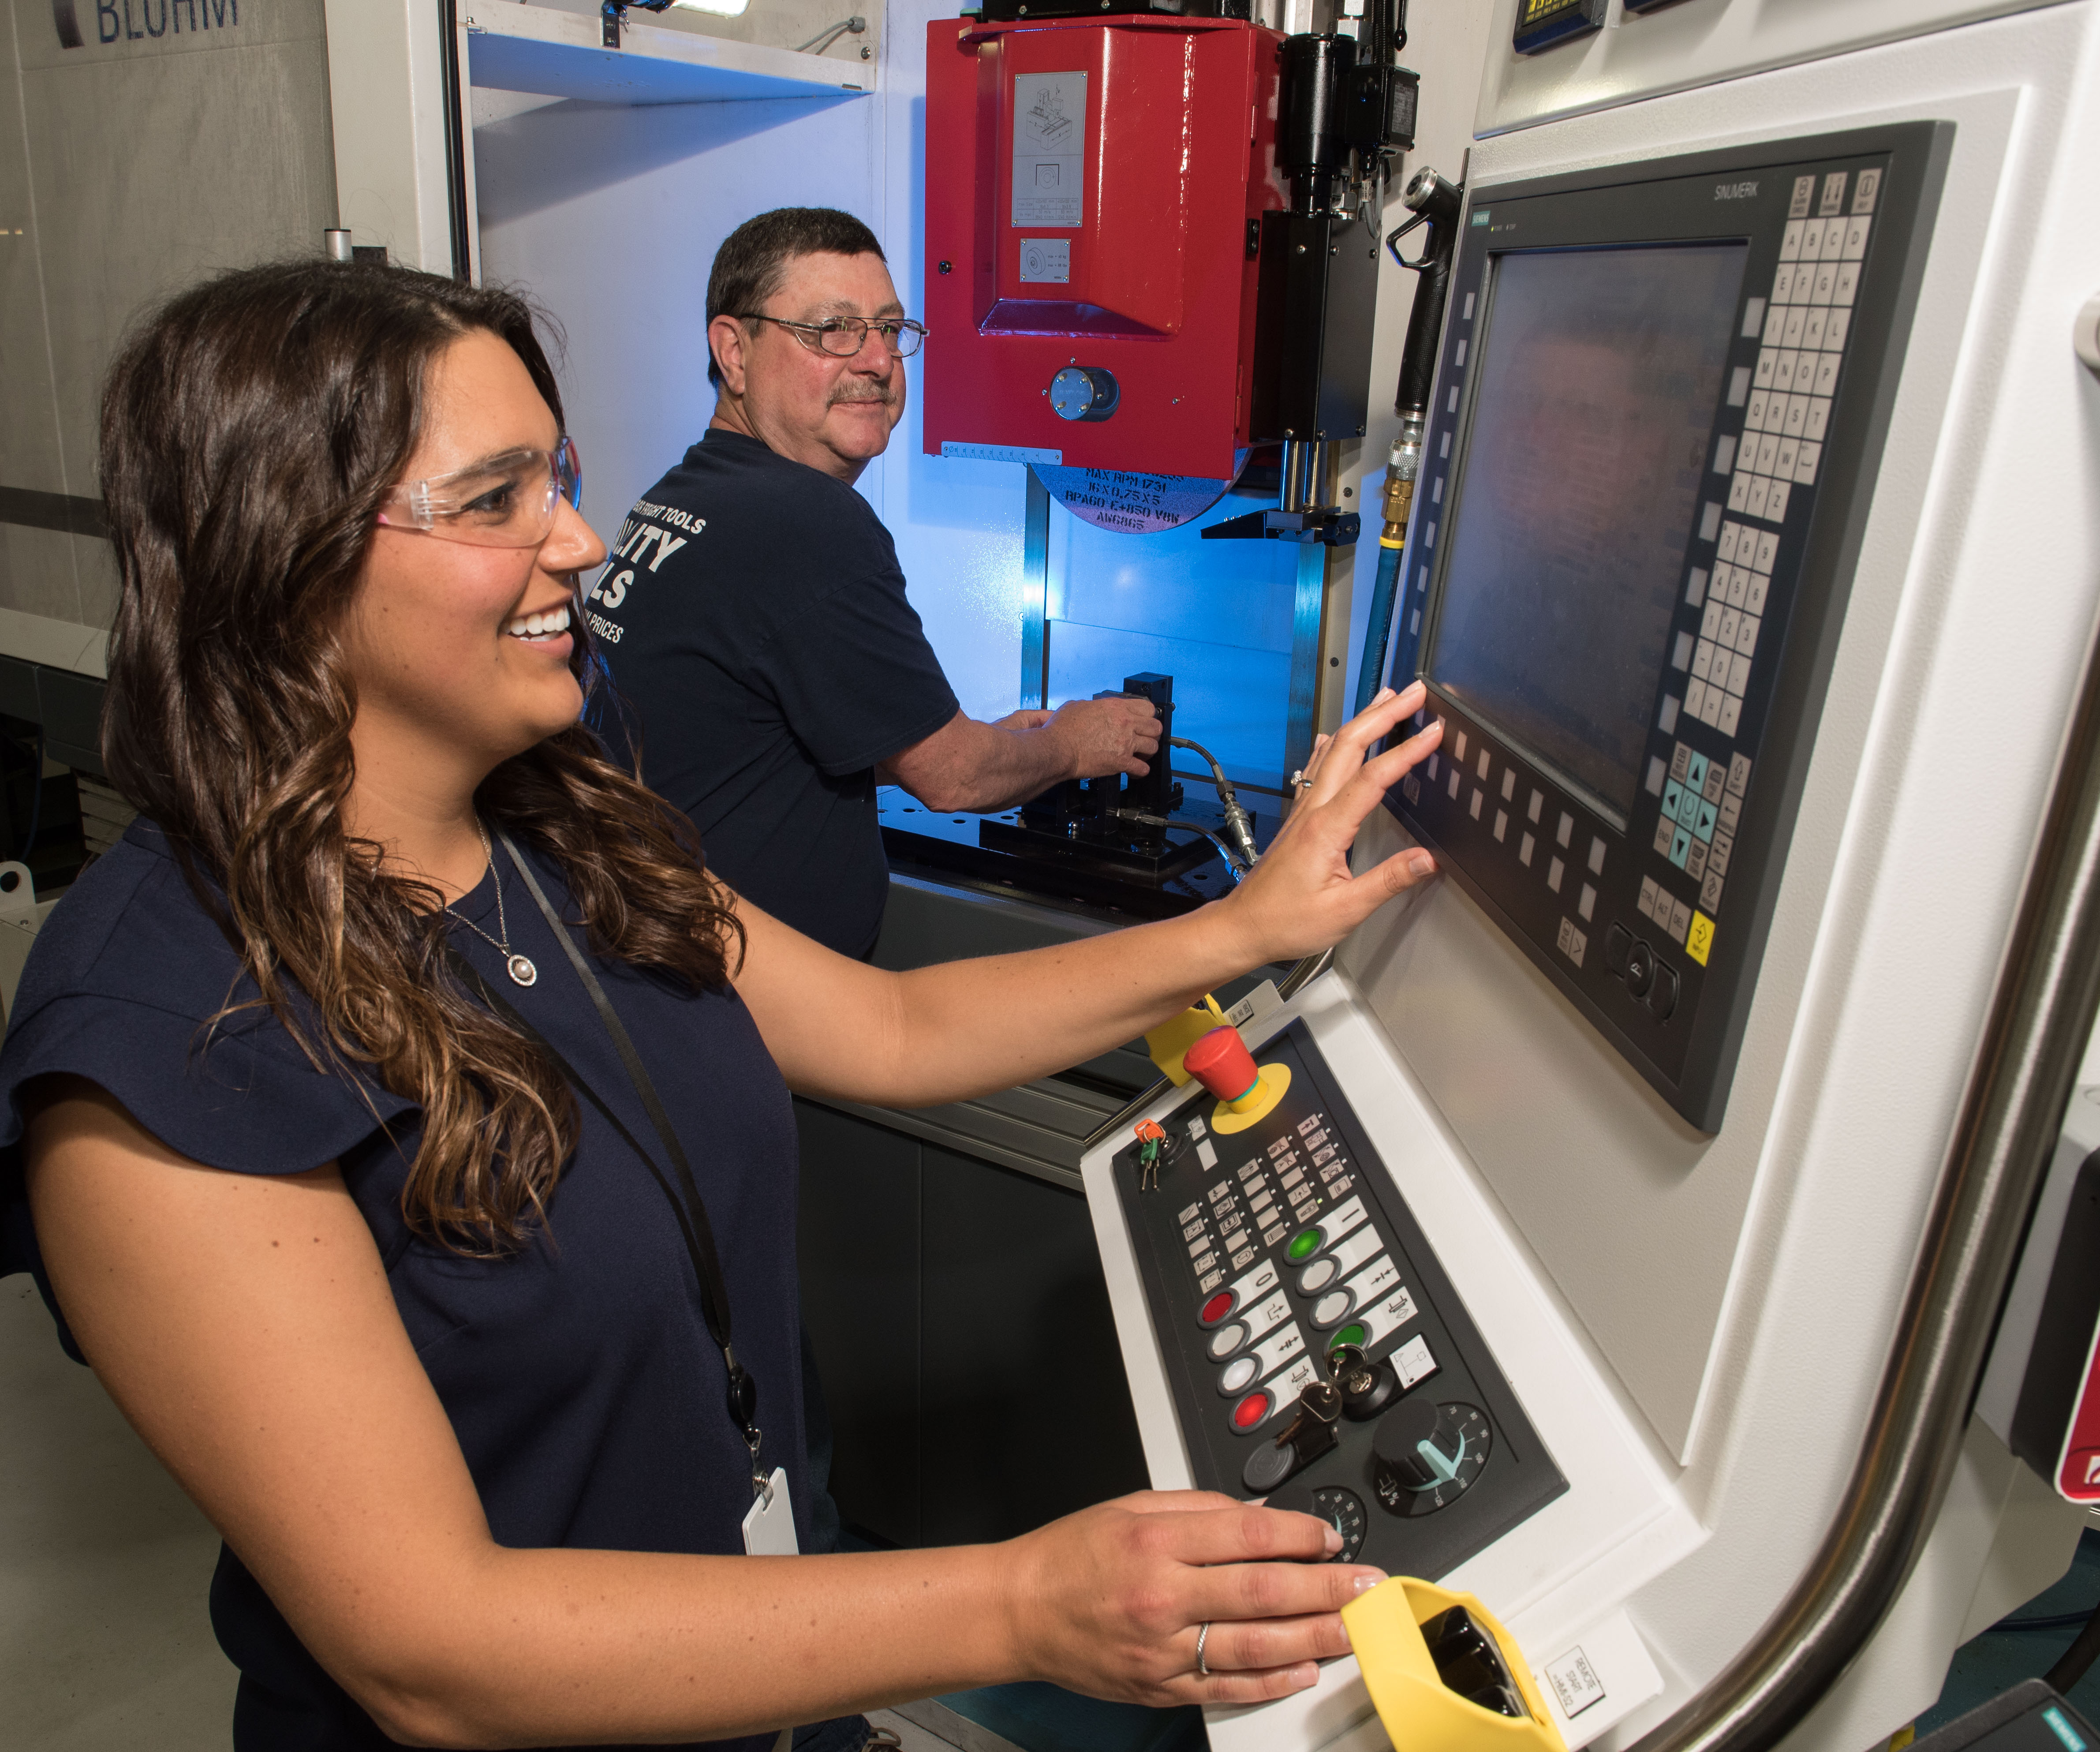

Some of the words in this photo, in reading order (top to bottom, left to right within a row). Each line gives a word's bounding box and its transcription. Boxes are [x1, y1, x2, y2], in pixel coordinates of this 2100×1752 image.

[1715, 181, 1760, 201] SINUMERIK
[1473, 214, 1489, 224] SIEMENS
[1788, 235, 1794, 247] A
[1809, 234, 1816, 247] B
[1830, 232, 1837, 245] C
[1851, 231, 1859, 244] D
[1780, 277, 1786, 290] E
[1799, 277, 1806, 290] F
[1820, 277, 1827, 291] G
[1842, 277, 1850, 290] H
[1790, 321, 1797, 334] J
[1811, 322, 1818, 334] K
[1833, 323, 1838, 337] L
[1762, 362, 1769, 374] M
[1801, 366, 1809, 379] O
[1823, 367, 1830, 381] P
[1793, 409, 1799, 423] S
[1814, 412, 1820, 425] T
[1745, 445, 1752, 457] U
[1764, 448, 1770, 460] V
[1783, 452, 1791, 464] W
[1087, 468, 1110, 481] MAX
[1114, 472, 1138, 486] RPM
[1736, 487, 1742, 498] X
[1756, 491, 1761, 502] Y
[1152, 495, 1161, 506] 5
[1774, 494, 1781, 508] Z
[661, 507, 706, 534] TOOLS
[1726, 535, 1731, 547] 7
[1717, 577, 1722, 586] 4
[590, 614, 624, 643] PRICES
[1726, 622, 1731, 634] 2
[1744, 629, 1750, 641] 3
[1450, 1406, 1457, 1415] 70
[1470, 1411, 1478, 1421] 80
[1480, 1429, 1488, 1438] 90
[1475, 1453, 1484, 1464] 100
[1459, 1477, 1467, 1489] 110
[1334, 1494, 1342, 1503] 30
[1435, 1495, 1444, 1507] 120
[1346, 1502, 1354, 1512] 50
[1352, 1516, 1360, 1527] 70
[1575, 1657, 1596, 1690] REMOTE
[1566, 1670, 1582, 1692] START
